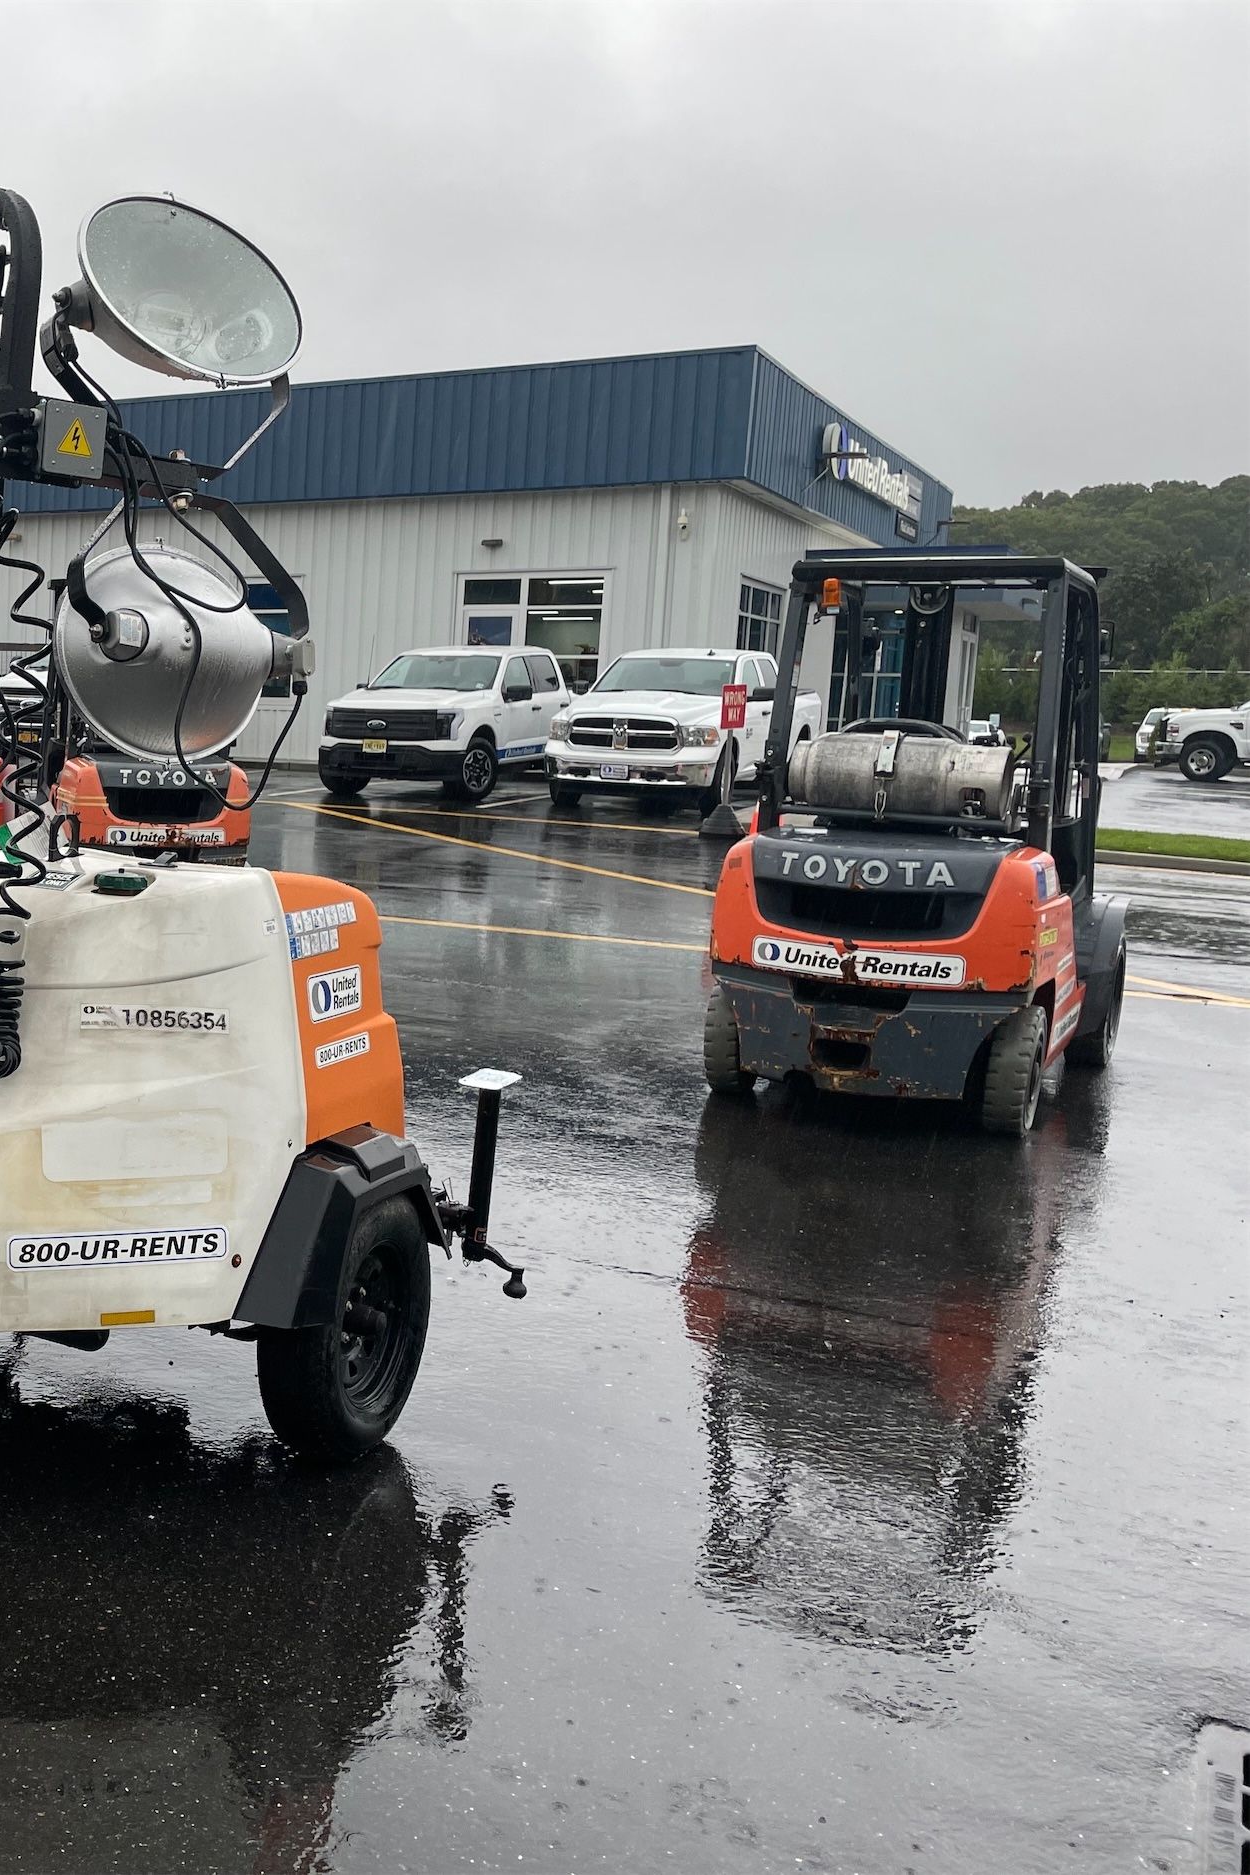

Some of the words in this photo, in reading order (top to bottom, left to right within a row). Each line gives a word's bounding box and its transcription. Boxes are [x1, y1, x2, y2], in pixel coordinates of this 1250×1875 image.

[847, 438, 882, 494] United
[878, 459, 910, 511] Rentals
[724, 690, 746, 706] WRONG
[728, 707, 741, 722] WAY
[129, 831, 167, 843] Unite
[781, 850, 955, 888] TOYOTA
[784, 946, 857, 970] Unite
[862, 955, 953, 980] Rentals
[331, 972, 358, 994] United
[333, 989, 360, 1010] Rentals
[121, 1008, 227, 1031] 10856354
[319, 1036, 367, 1064] 800-UR-RENTS
[18, 1232, 219, 1264] 800-UR-RENTS
